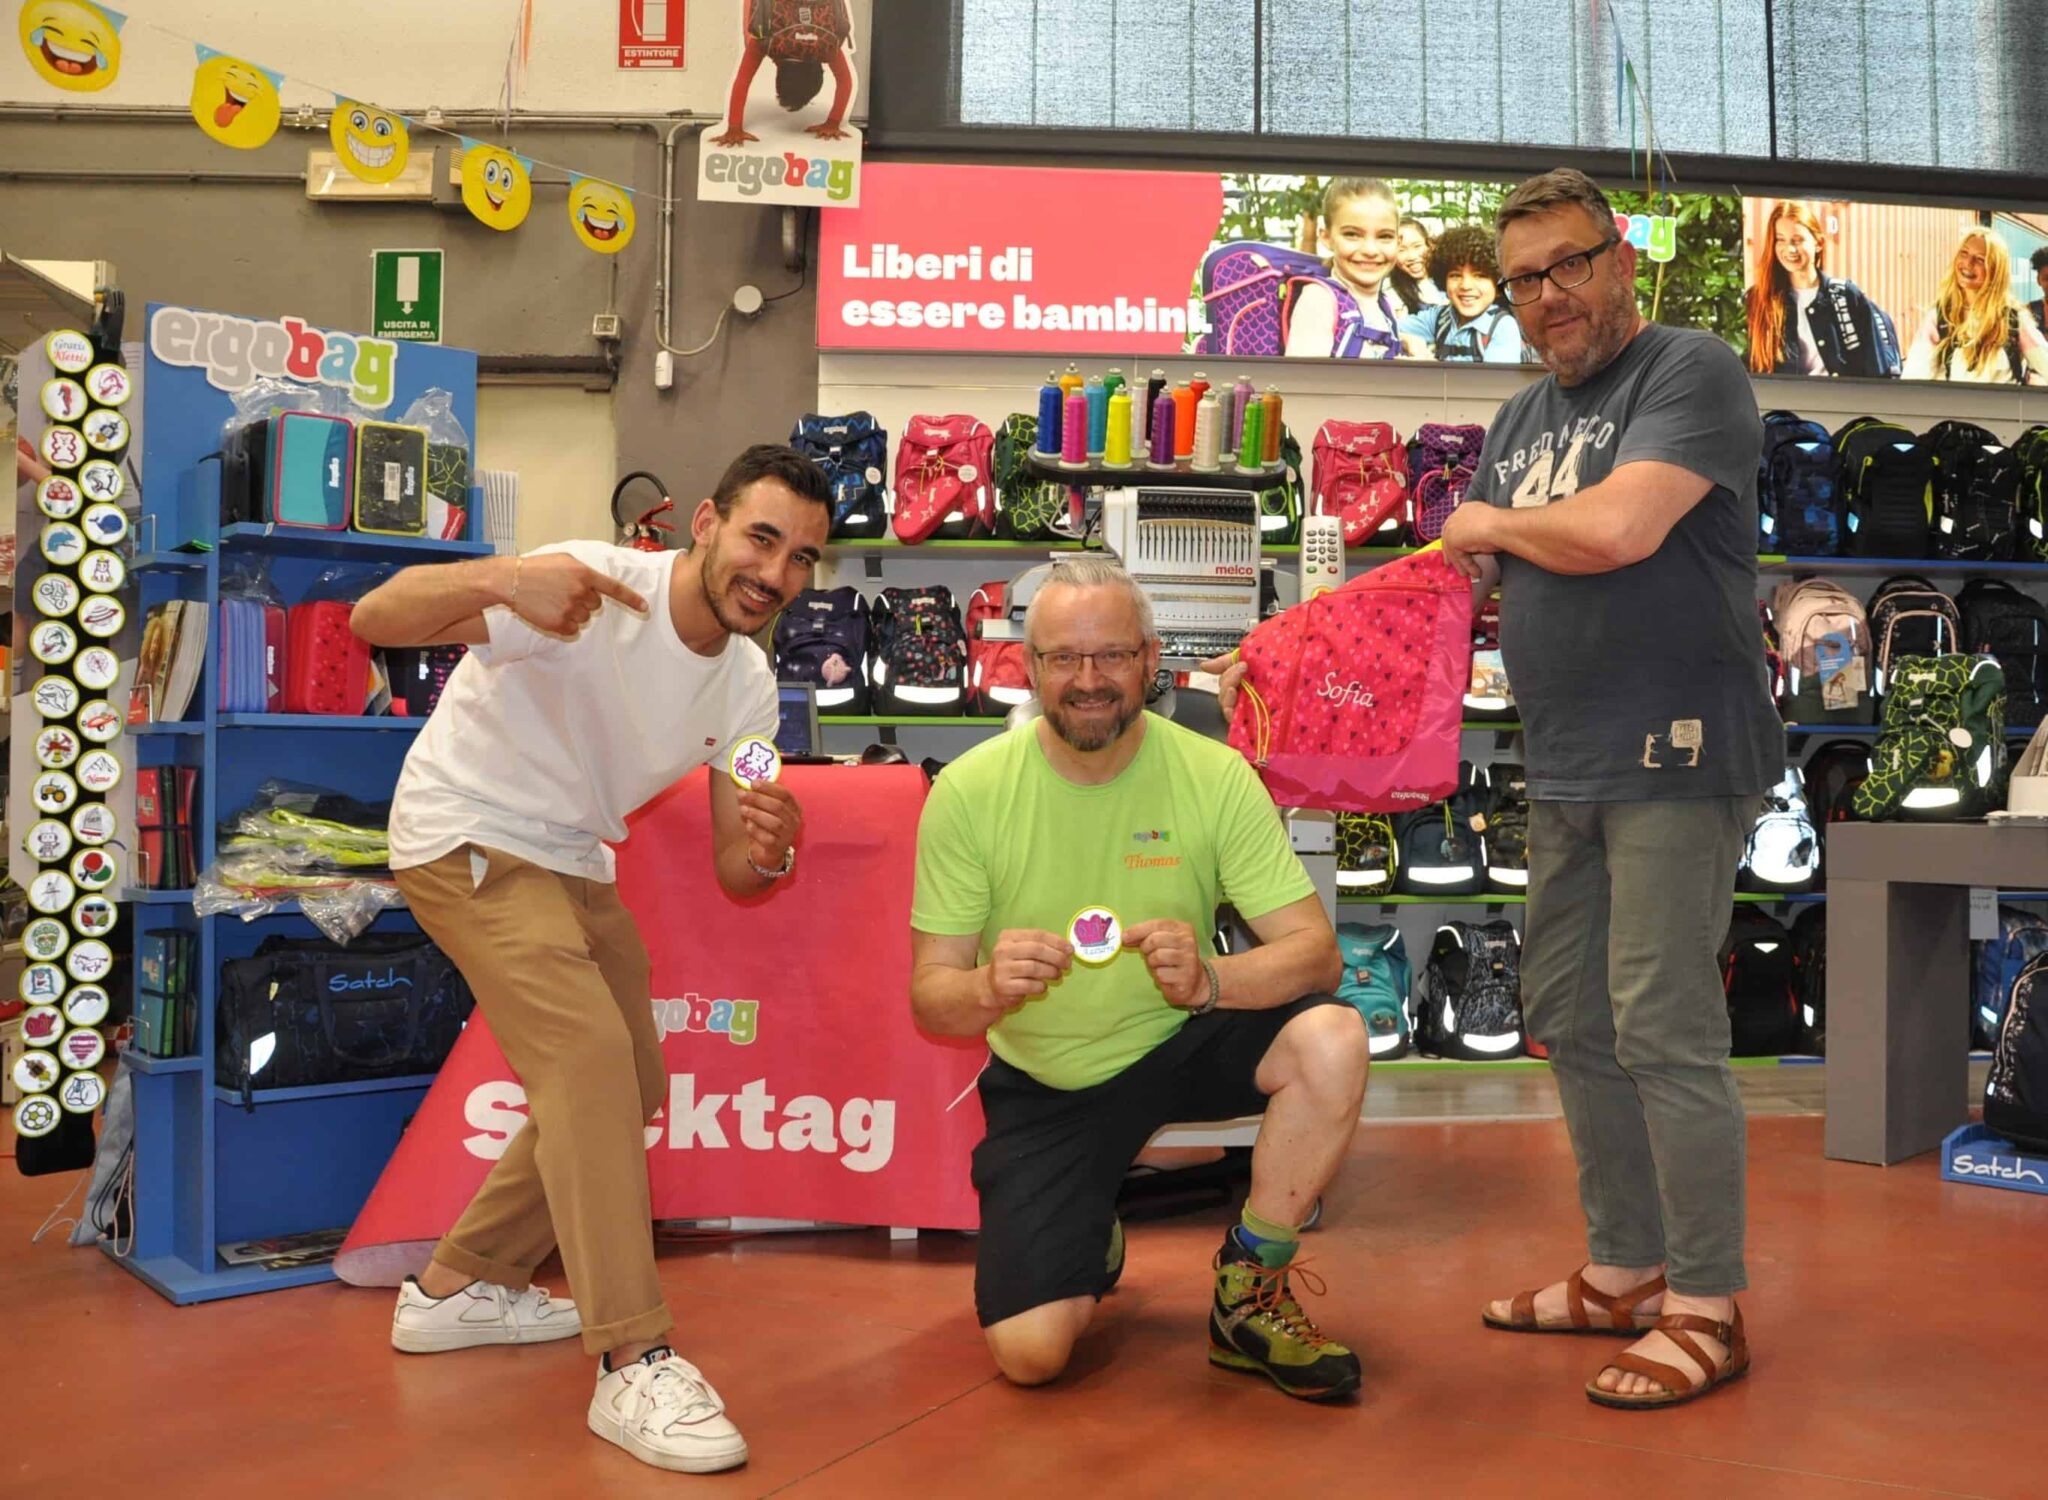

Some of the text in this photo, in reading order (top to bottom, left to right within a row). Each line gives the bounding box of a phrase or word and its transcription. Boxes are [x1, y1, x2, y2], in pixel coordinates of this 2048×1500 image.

[624, 49, 679, 58] ESTINTORE
[705, 152, 854, 200] ergobag
[842, 243, 1033, 282] Liberi di
[383, 320, 431, 329] USCITA DI
[841, 298, 1006, 329] essere
[377, 330, 436, 339] EMERGENZA
[152, 307, 397, 408] ergobag
[1495, 431, 1554, 485] FRED
[1511, 433, 1585, 509] 44
[1215, 565, 1253, 576] melco
[1316, 671, 1375, 708] Sofia
[1124, 853, 1183, 870] Thomas
[651, 992, 760, 1045] obag
[462, 1073, 897, 1173] Sktag
